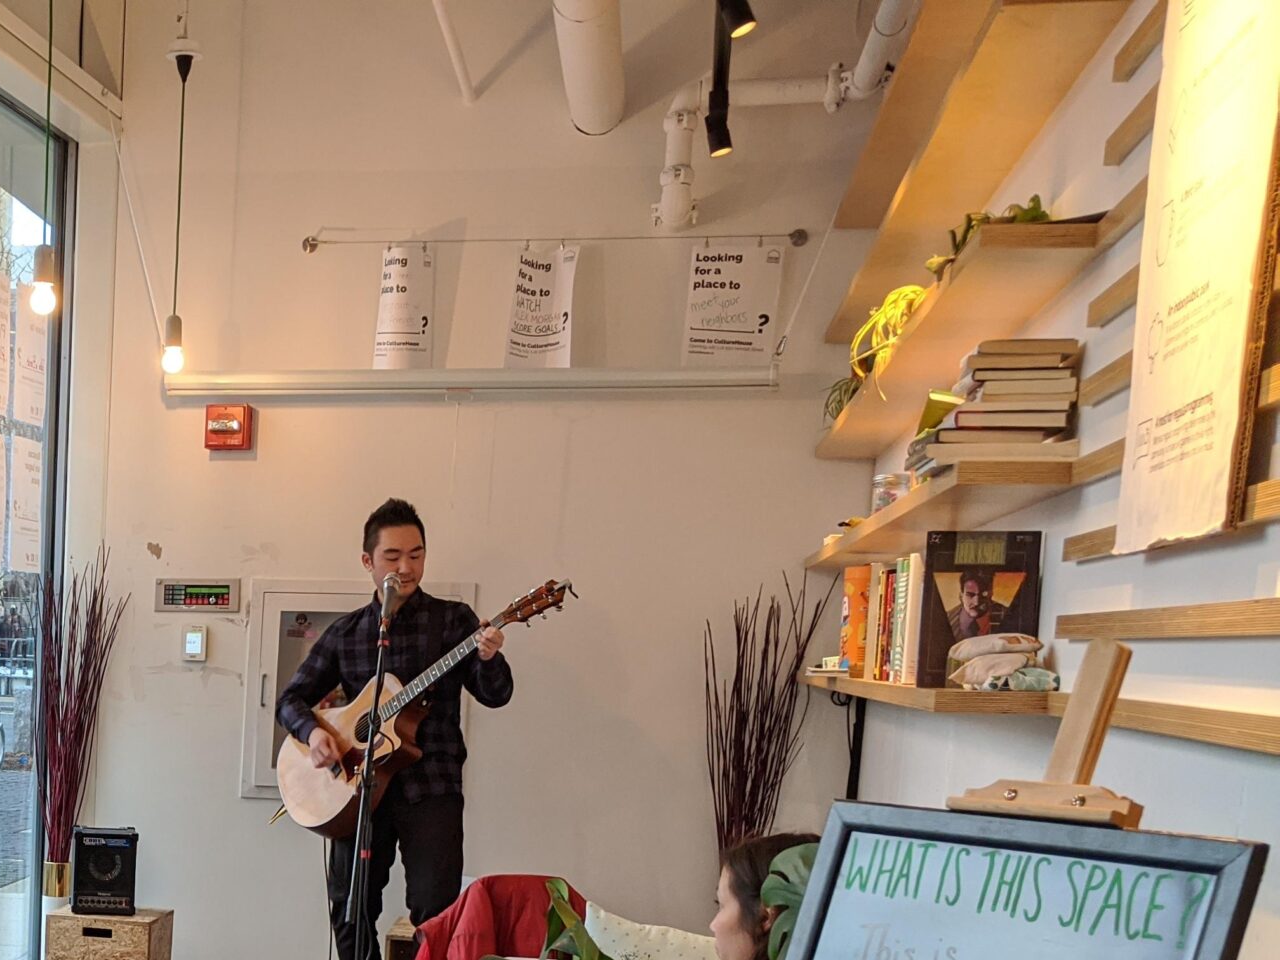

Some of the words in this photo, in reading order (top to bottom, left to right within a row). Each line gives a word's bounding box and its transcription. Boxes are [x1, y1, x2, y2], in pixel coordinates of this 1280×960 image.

[520, 254, 552, 272] Looking
[696, 253, 743, 264] Looking
[518, 268, 528, 280] for
[695, 266, 712, 275] for
[396, 284, 407, 293] to
[516, 283, 537, 297] place
[539, 287, 551, 297] to
[693, 279, 726, 291] place
[729, 281, 740, 289] to
[721, 297, 741, 312] your
[422, 316, 429, 334] ?
[562, 312, 569, 331] ?
[758, 314, 770, 334] ?
[845, 837, 938, 900] WHAT
[935, 846, 971, 907] IS
[976, 850, 1052, 923] THIS
